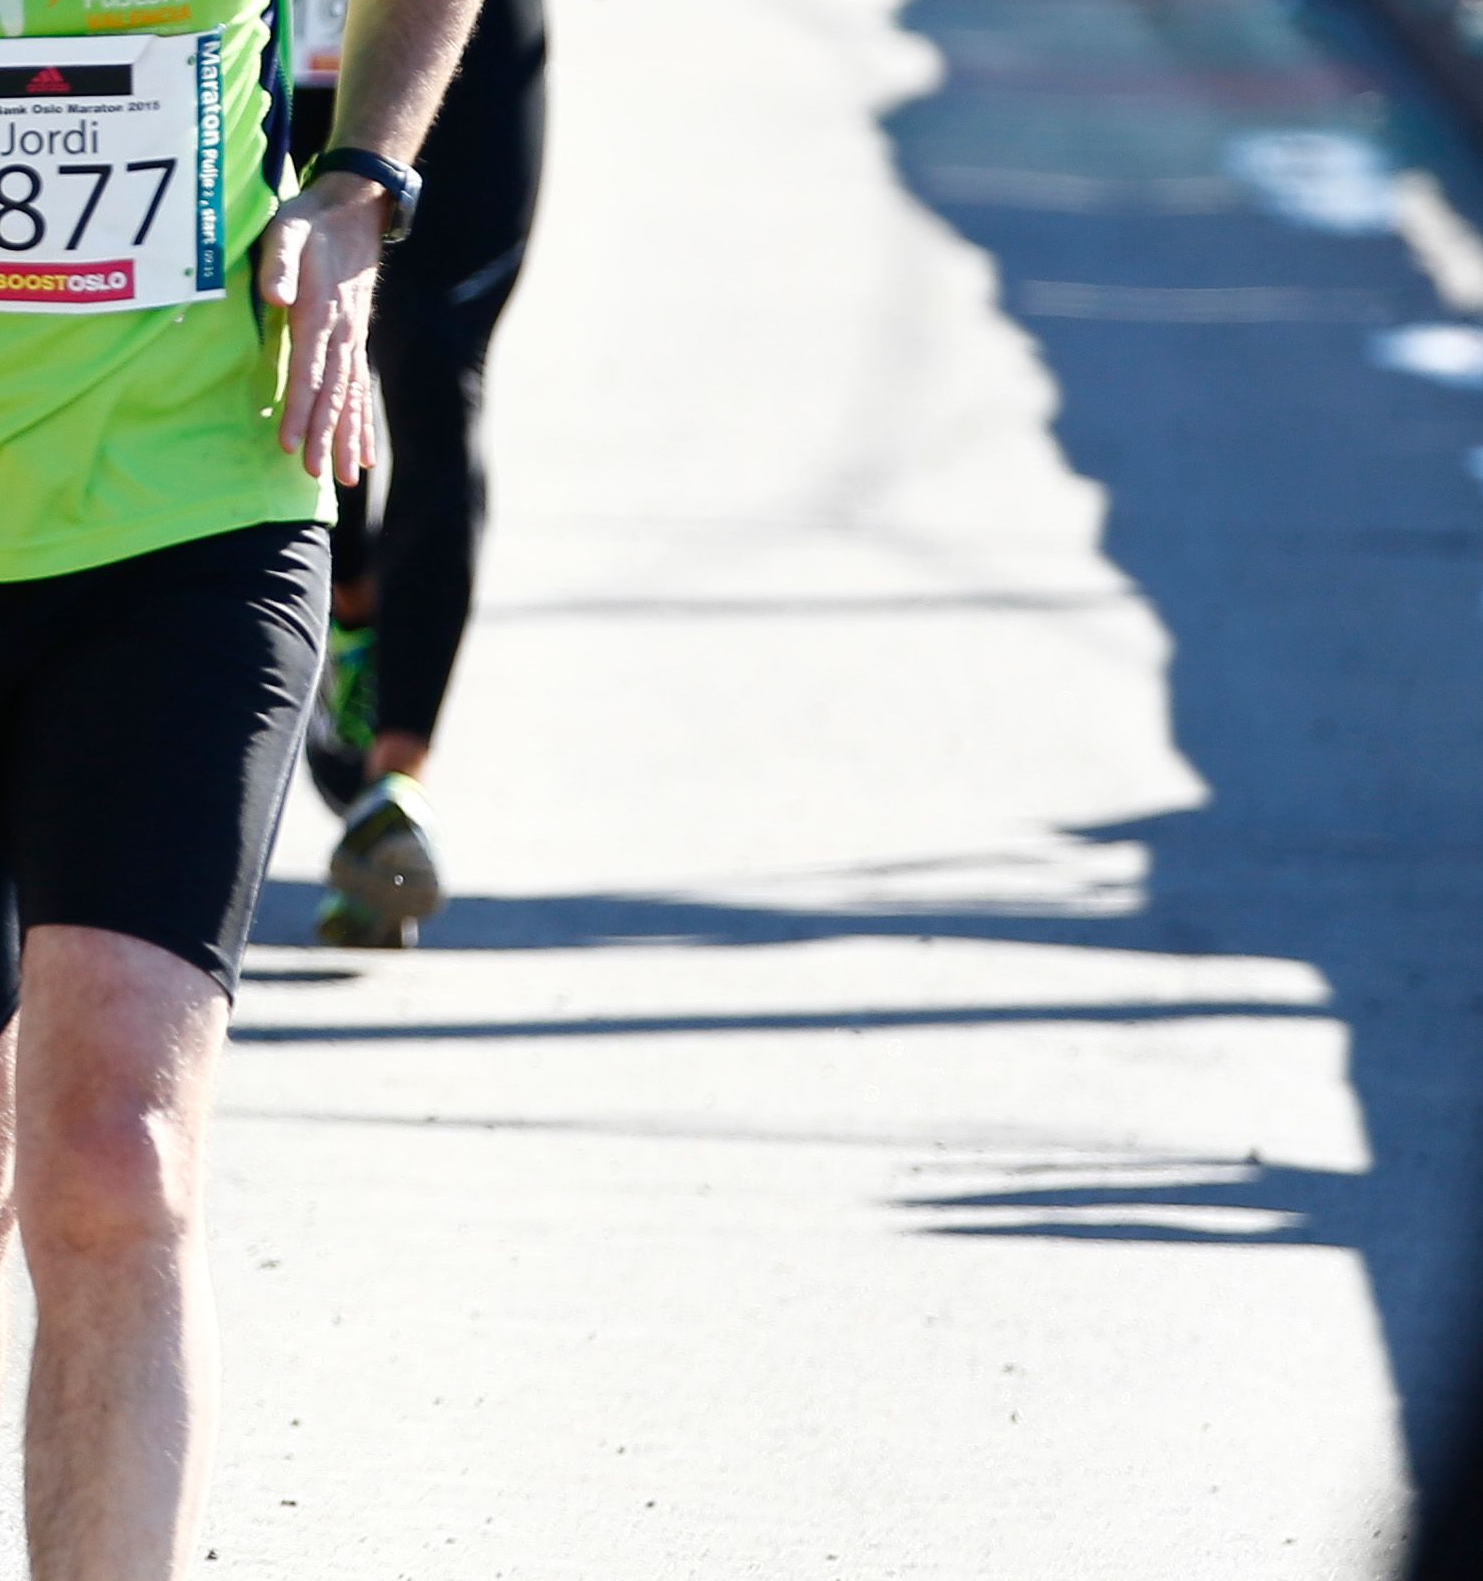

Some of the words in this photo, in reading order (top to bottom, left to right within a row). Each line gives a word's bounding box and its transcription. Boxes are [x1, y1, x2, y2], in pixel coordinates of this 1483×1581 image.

[32, 103, 63, 114] Oslo
[67, 102, 124, 114] Maraton
[128, 100, 161, 111] 2015
[200, 41, 222, 147] Maraton
[0, 120, 99, 157] Jordi
[199, 148, 219, 189] Pulje
[201, 208, 217, 244] start
